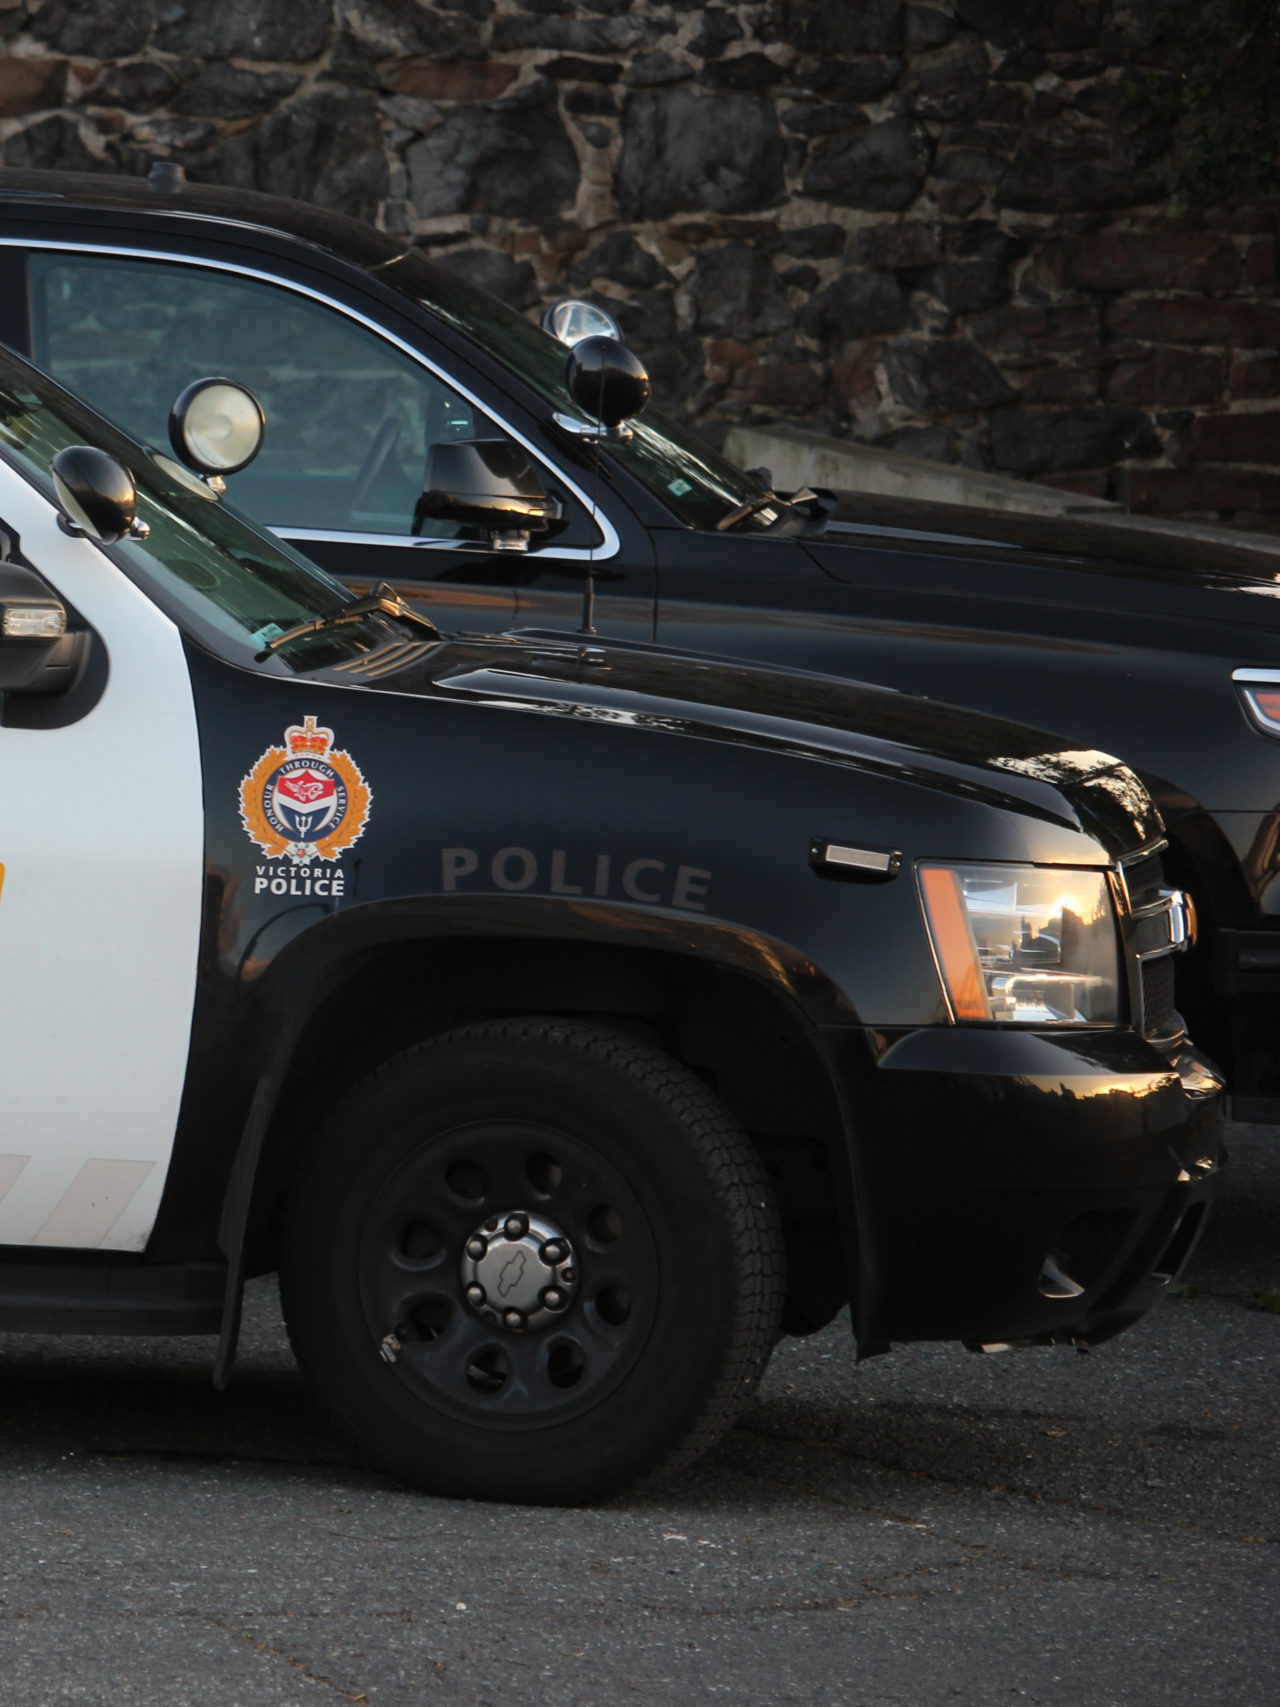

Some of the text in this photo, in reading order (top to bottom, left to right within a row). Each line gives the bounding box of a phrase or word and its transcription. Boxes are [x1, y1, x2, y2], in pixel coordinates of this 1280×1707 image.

[263, 760, 346, 832] HONOUR THROUGH SERVICE
[254, 878, 345, 896] POLICE
[255, 865, 345, 879] VICTORIA
[442, 847, 713, 910] POLICE
